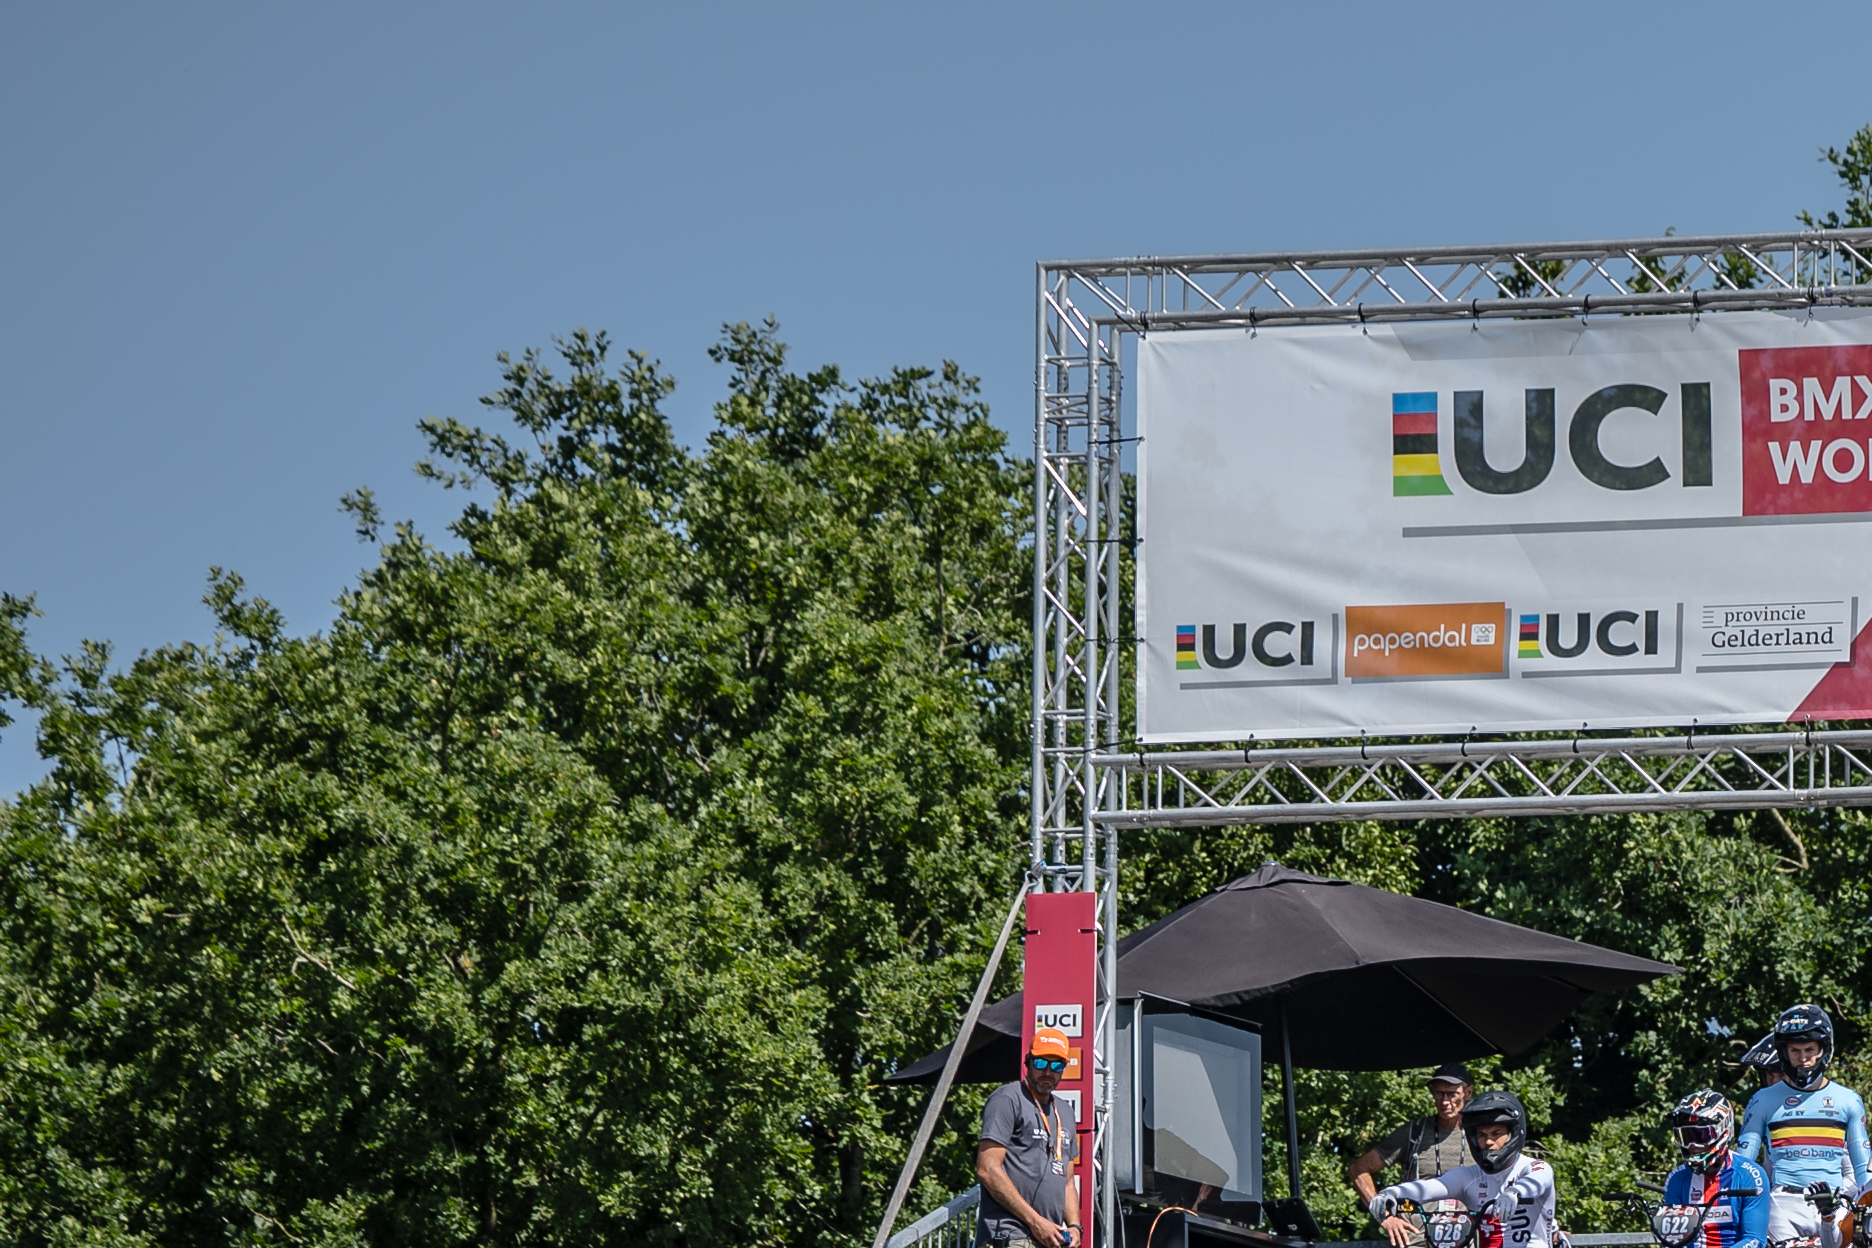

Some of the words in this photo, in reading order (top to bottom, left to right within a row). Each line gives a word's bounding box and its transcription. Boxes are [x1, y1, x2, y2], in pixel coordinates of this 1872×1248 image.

[1453, 382, 1713, 495] UCI
[1724, 605, 1807, 627] provincie
[1202, 620, 1315, 669] UCI
[1353, 623, 1467, 657] papendal
[1545, 610, 1659, 658] UCI
[1711, 627, 1834, 649] Gelderland
[1044, 1013, 1077, 1028] UCI
[1434, 1223, 1463, 1241] 628
[1661, 1216, 1690, 1234] 622
